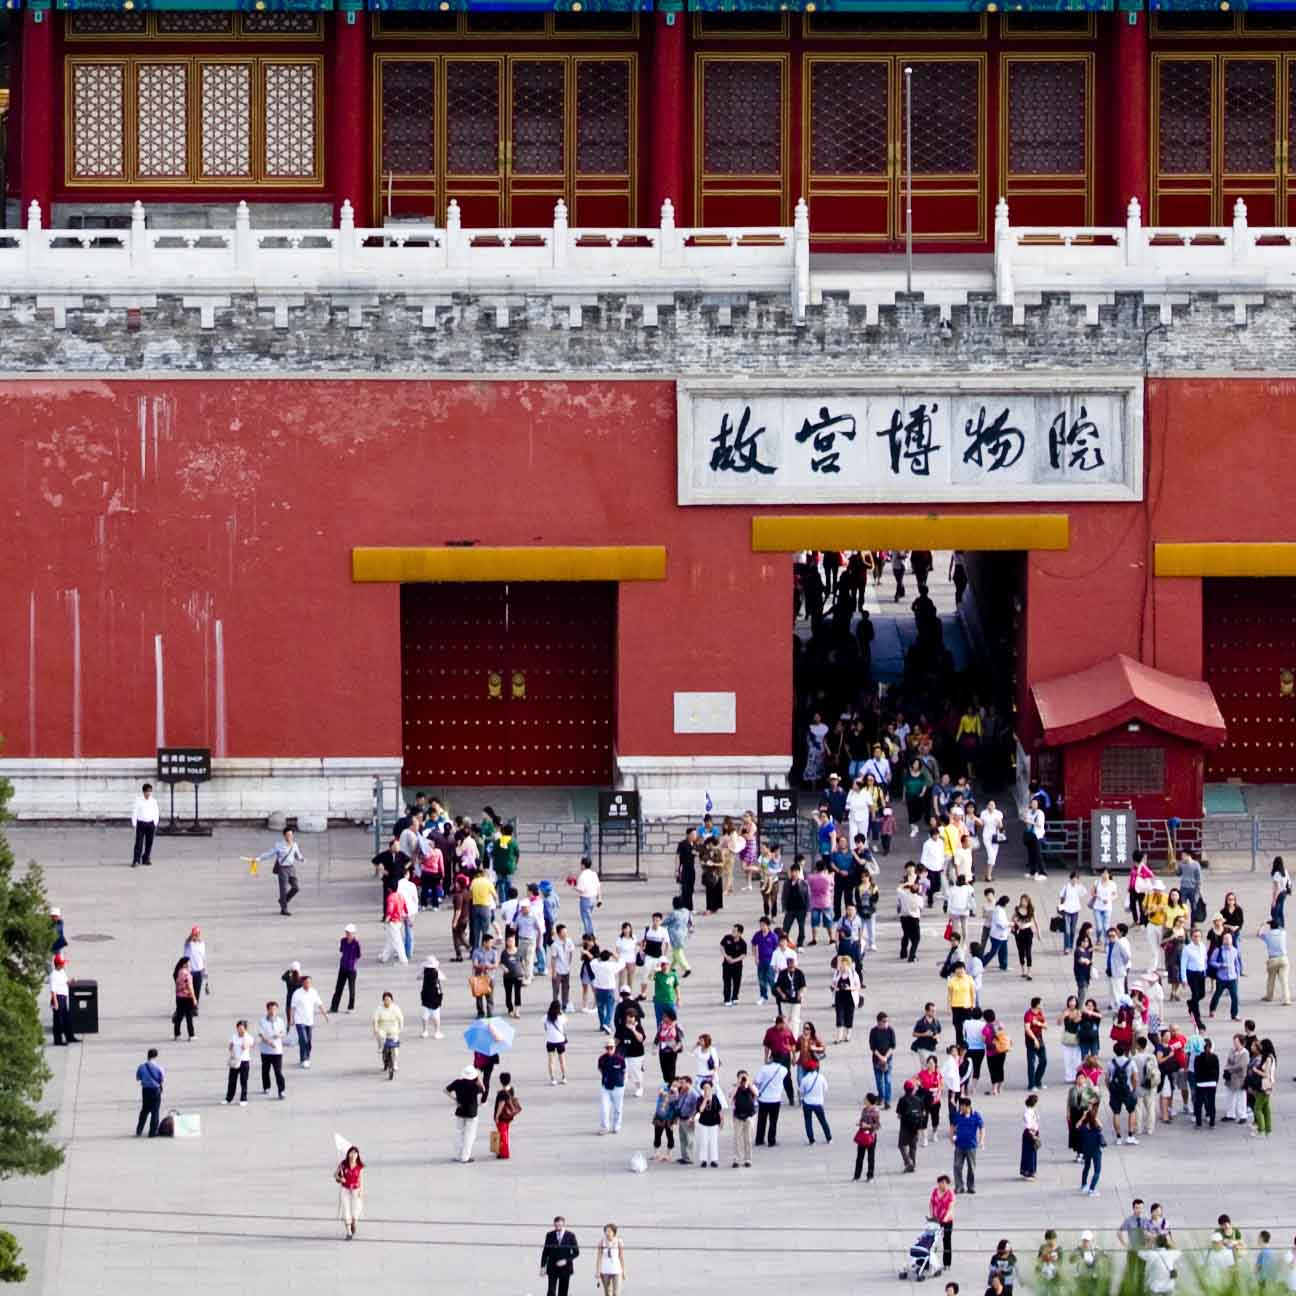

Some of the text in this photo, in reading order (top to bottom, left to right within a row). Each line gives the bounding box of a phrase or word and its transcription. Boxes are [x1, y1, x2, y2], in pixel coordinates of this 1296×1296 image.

[709, 403, 1105, 476] 故宫博物院
